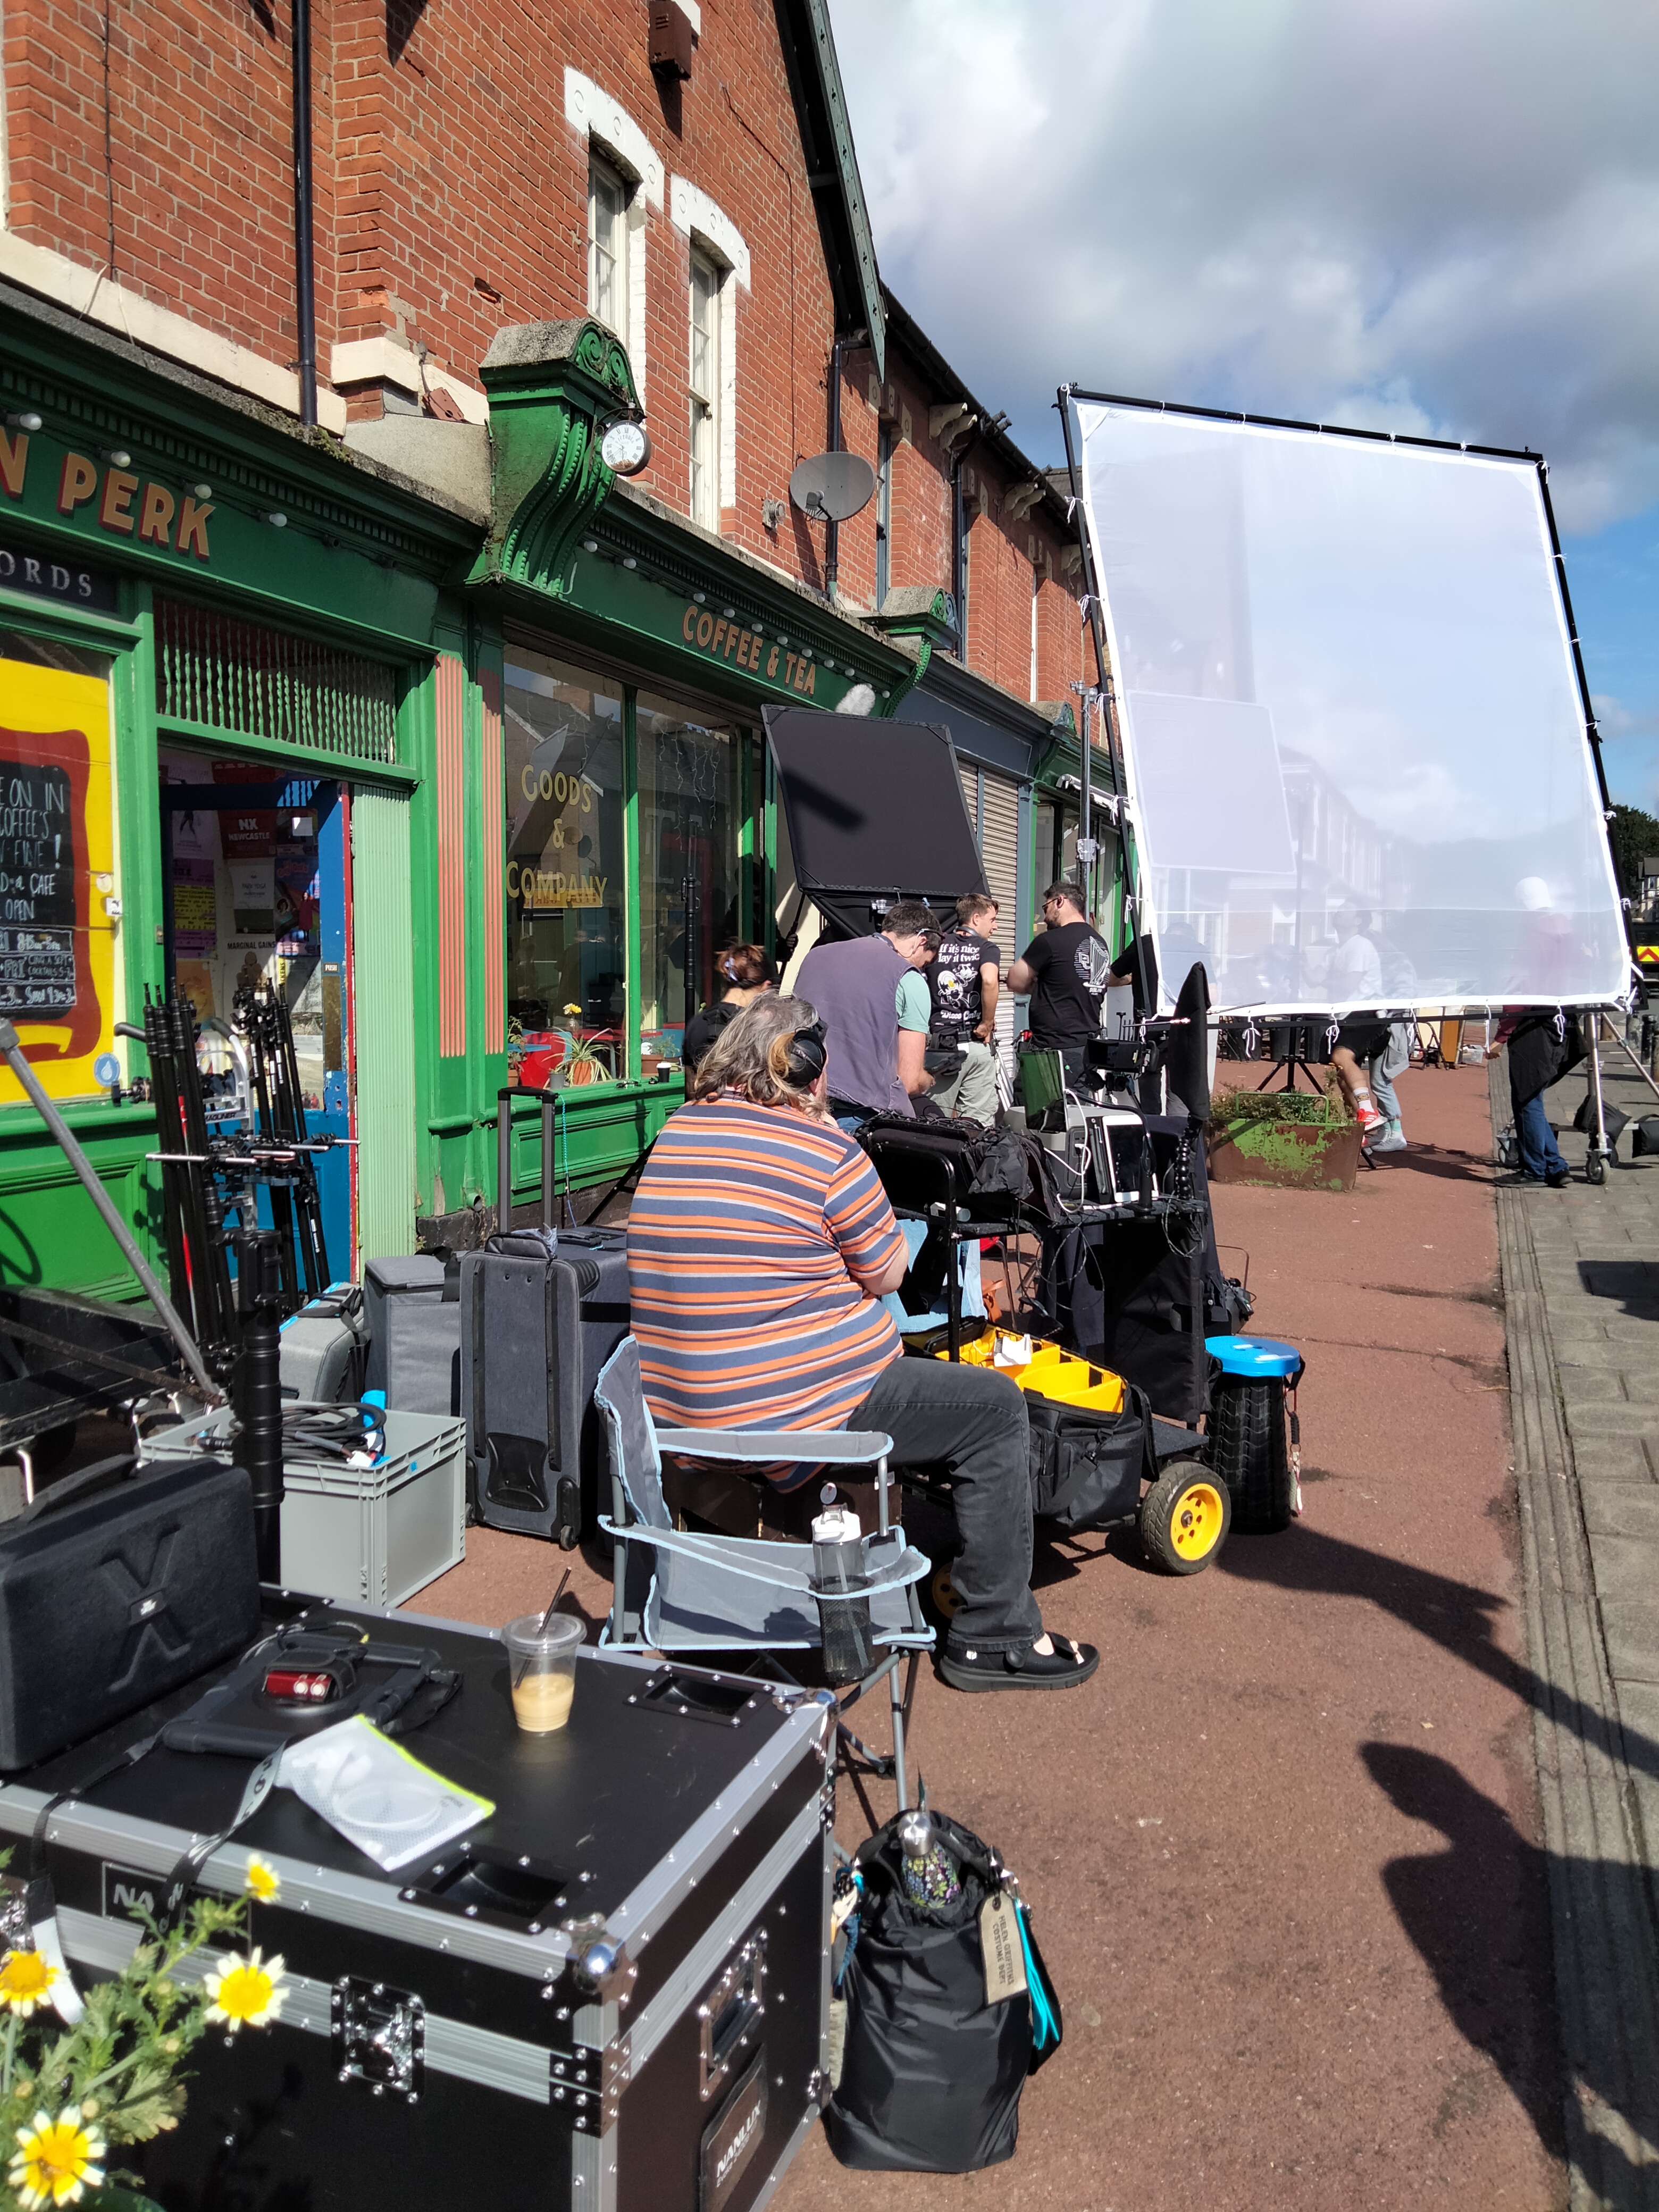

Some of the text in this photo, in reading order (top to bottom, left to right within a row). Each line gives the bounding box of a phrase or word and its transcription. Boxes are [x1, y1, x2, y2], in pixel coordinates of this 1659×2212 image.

[57, 451, 216, 560] PERK
[0, 550, 93, 597] ORDS
[683, 606, 816, 701] COFFEE & TEA
[9, 778, 32, 808] ON
[45, 782, 64, 814] IN
[228, 832, 270, 841] NEWCASTLE
[238, 818, 259, 831] NX
[553, 818, 565, 849] &
[5, 898, 36, 921] OPEN
[937, 953, 952, 964] lay
[960, 953, 981, 962] twic
[960, 943, 980, 953] nice
[963, 1010, 982, 1020] Only
[992, 1922, 1004, 1963] COSTUME
[998, 1915, 1015, 1986] HELEN GRIFFITHS
[716, 2099, 761, 2179] NANLUX
